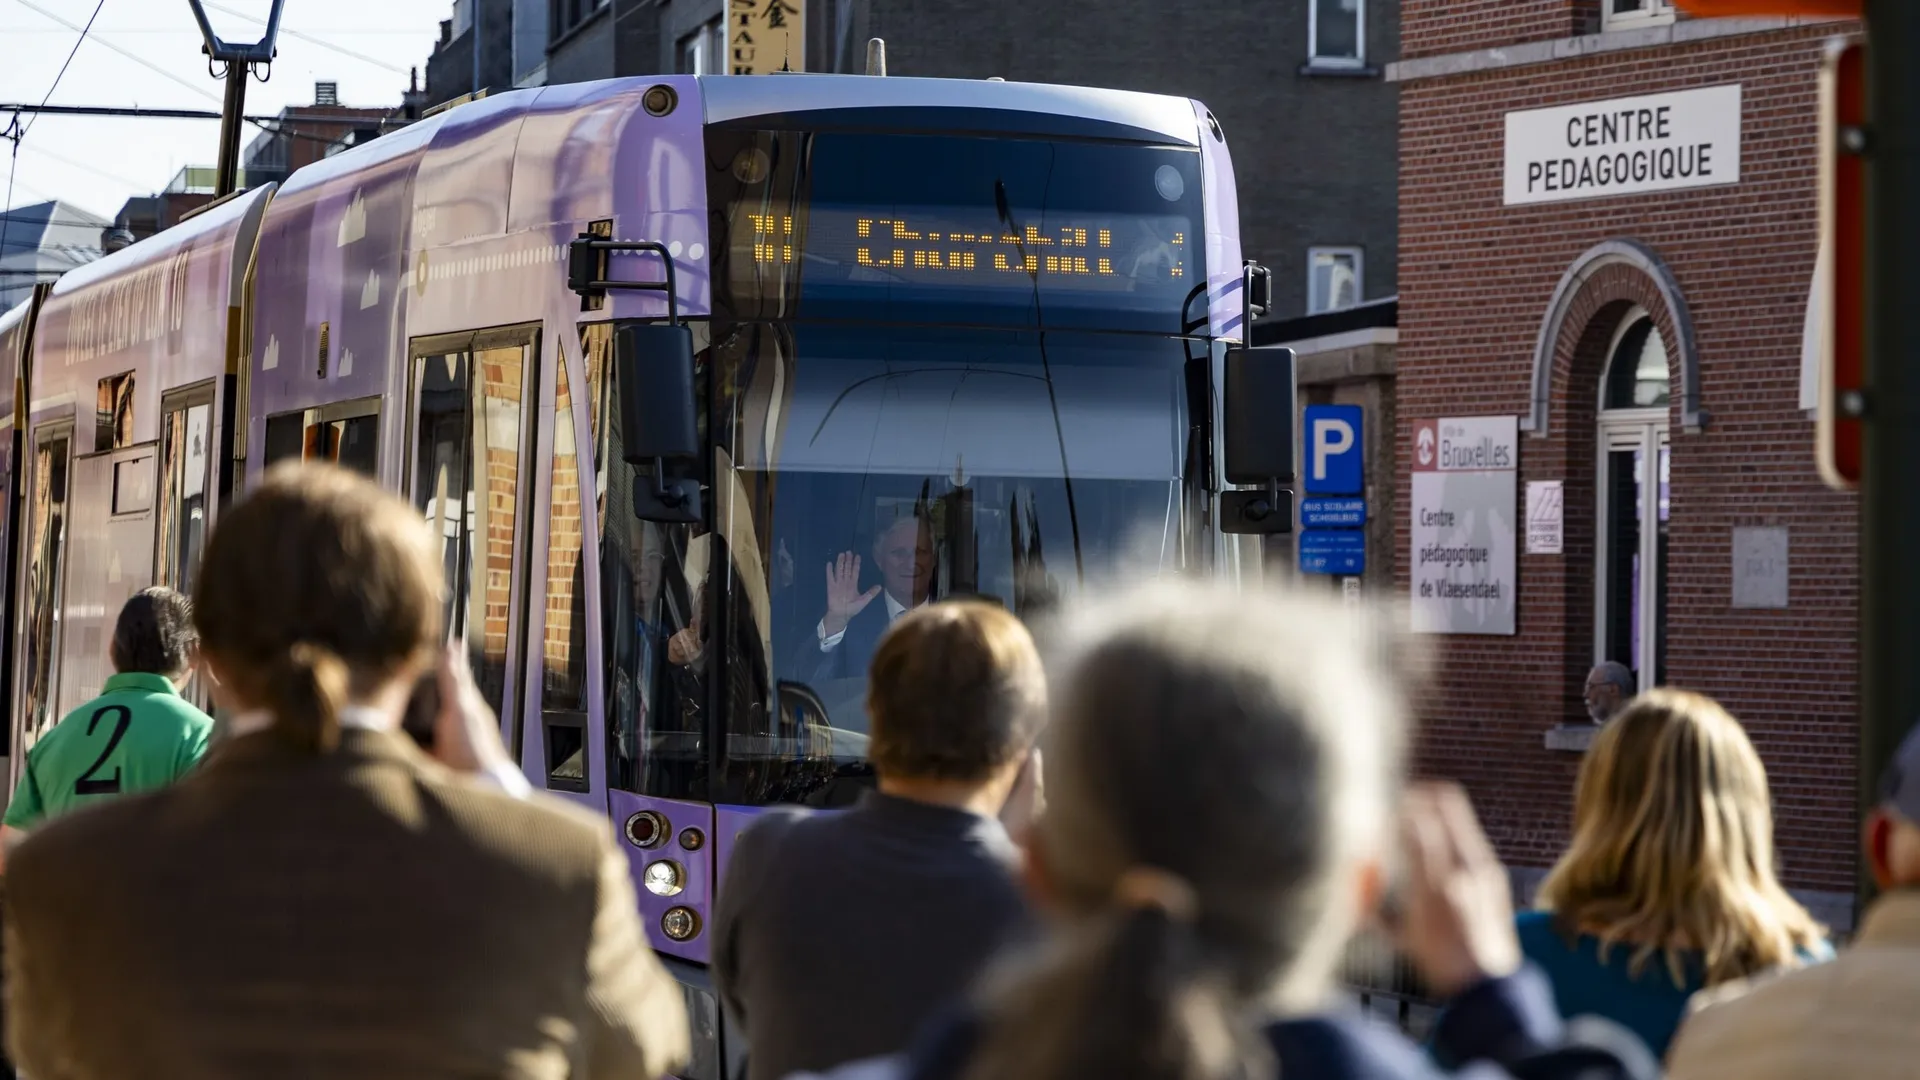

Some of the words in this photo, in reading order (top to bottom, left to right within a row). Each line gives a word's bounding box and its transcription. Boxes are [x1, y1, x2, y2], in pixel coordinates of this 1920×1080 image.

[1567, 106, 1670, 147] CENTRE
[1528, 143, 1712, 193] PEDAGOGIQUE
[171, 249, 189, 331] 10
[1313, 419, 1354, 480] P
[1442, 436, 1510, 467] Bruxelles
[1421, 507, 1455, 527] Centre
[1421, 543, 1488, 568] pédagogique
[1421, 578, 1433, 597] de
[75, 705, 131, 795] 2
